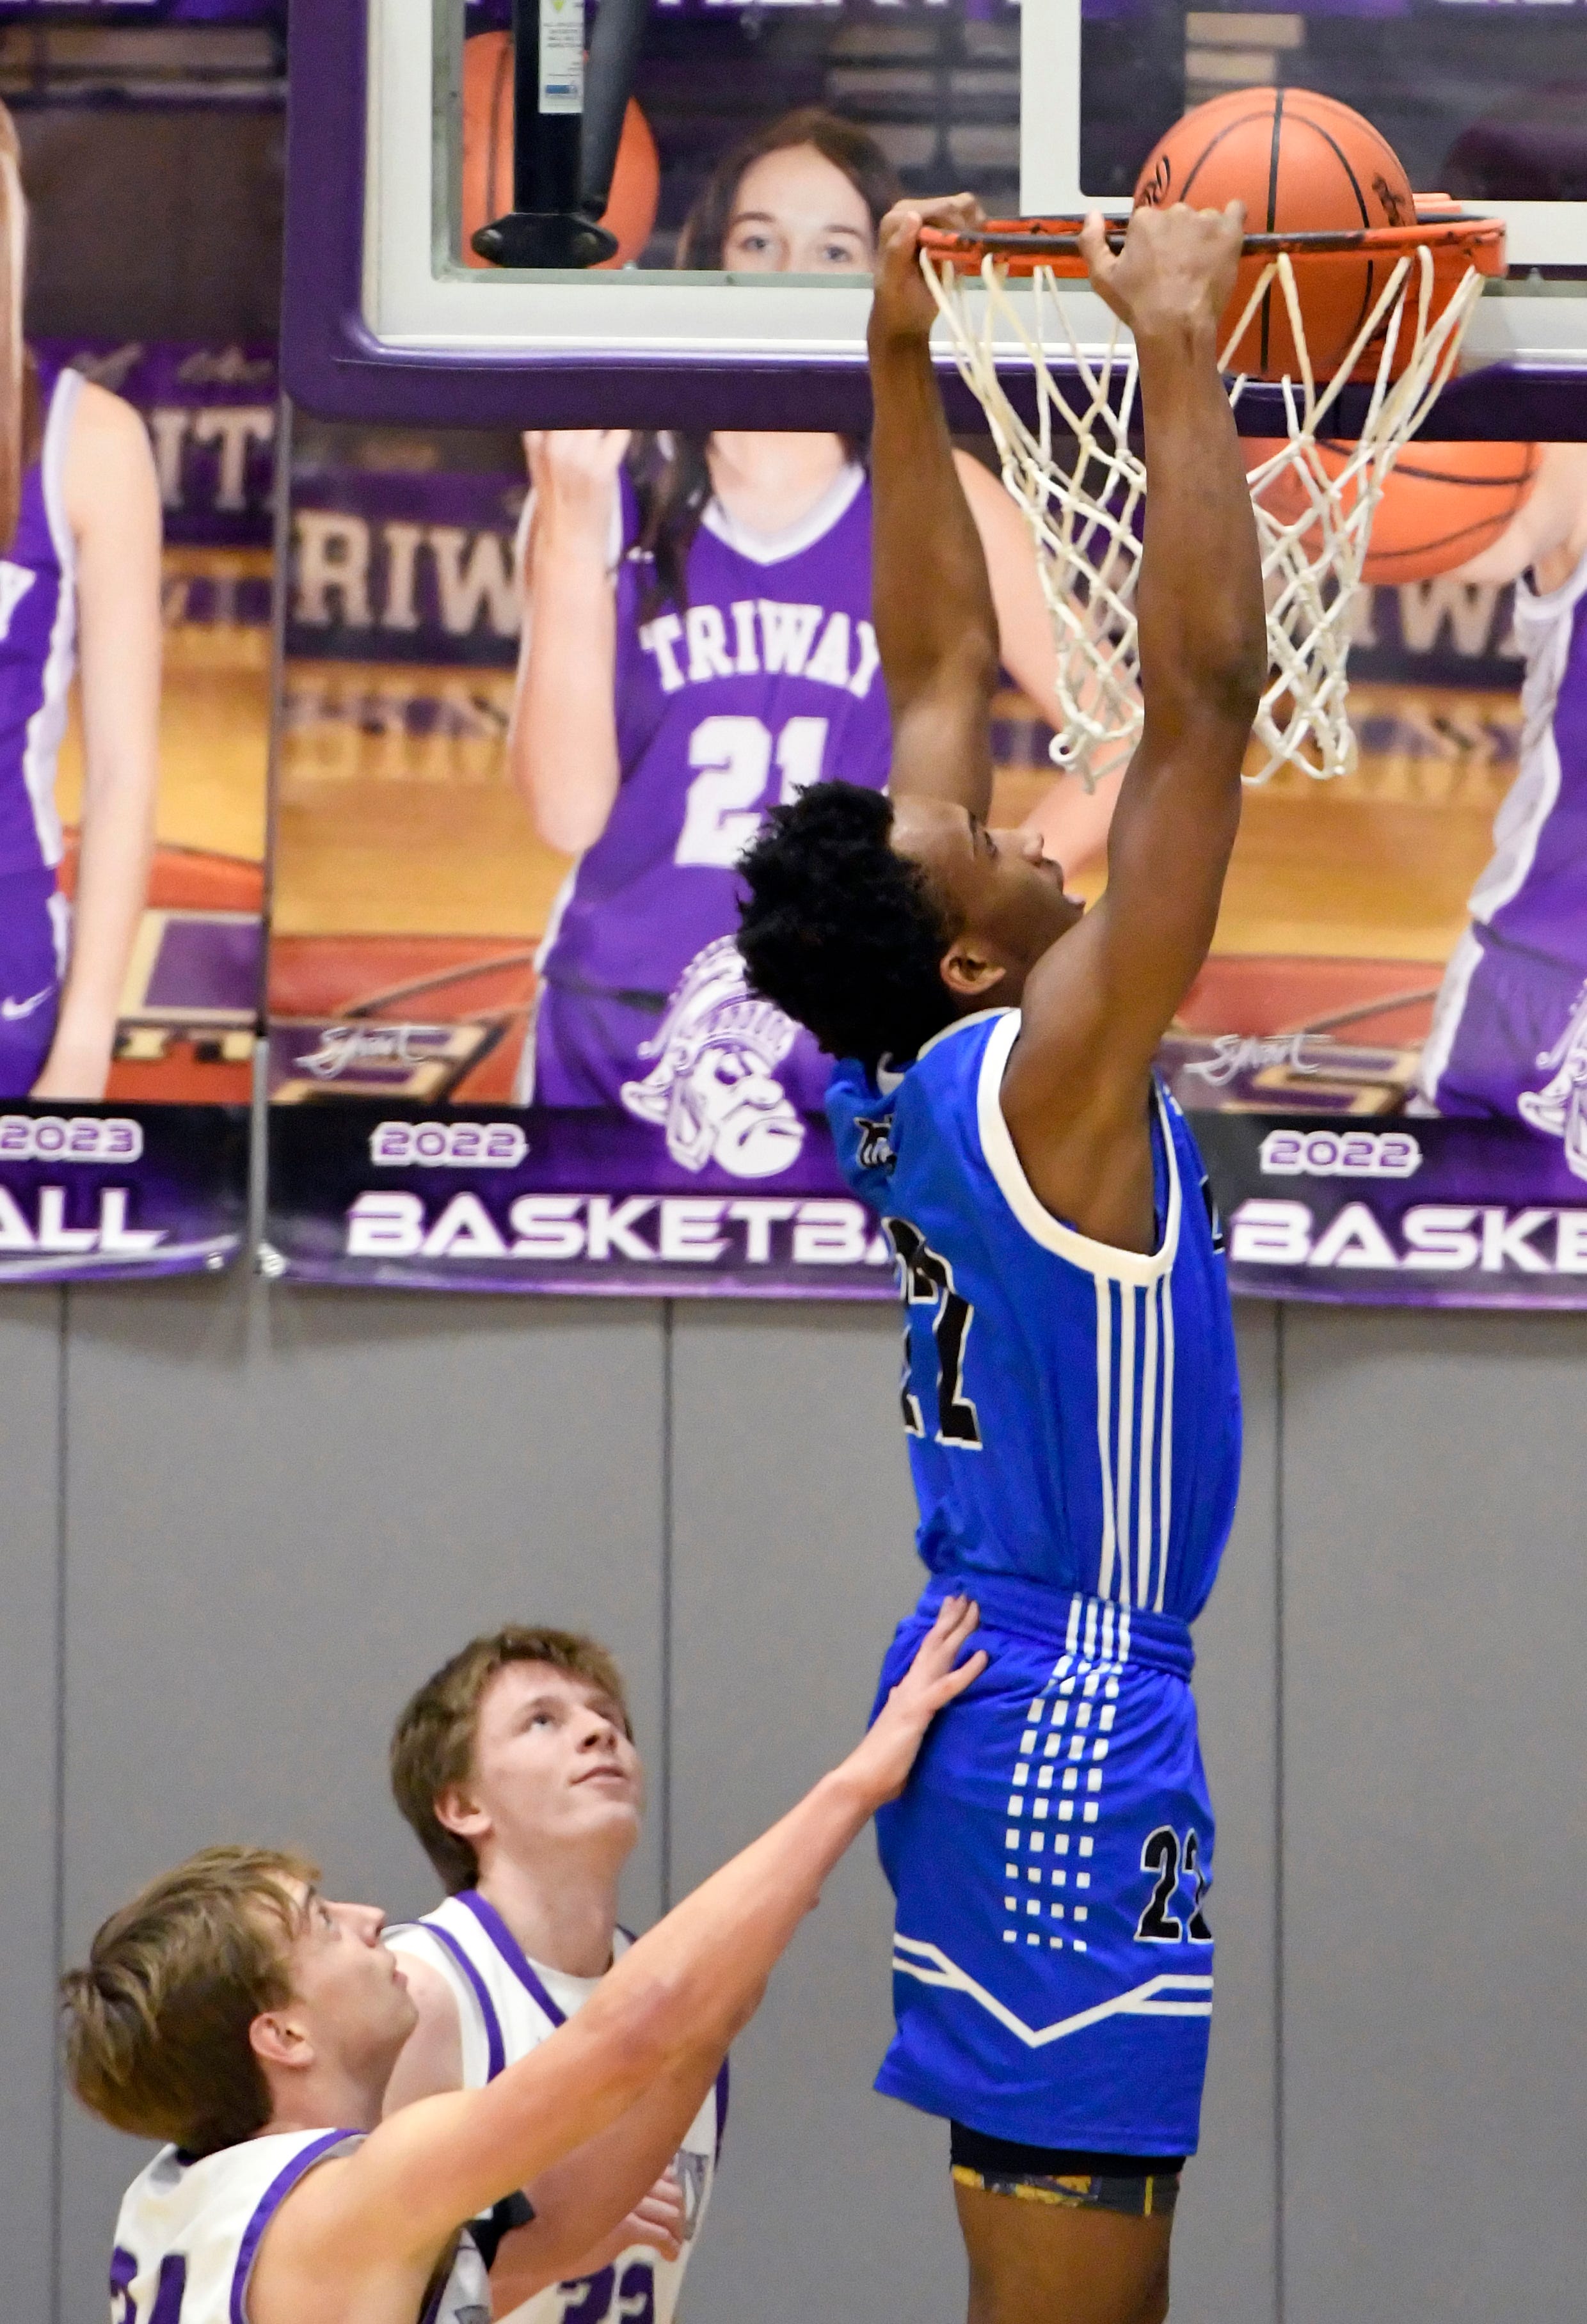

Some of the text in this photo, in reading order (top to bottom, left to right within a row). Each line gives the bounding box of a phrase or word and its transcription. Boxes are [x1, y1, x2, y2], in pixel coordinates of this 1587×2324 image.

[640, 598, 881, 699] TRIWAY
[0, 1117, 142, 1161] 2023
[373, 1124, 523, 1166] 2022
[1263, 1131, 1420, 1176] 2022
